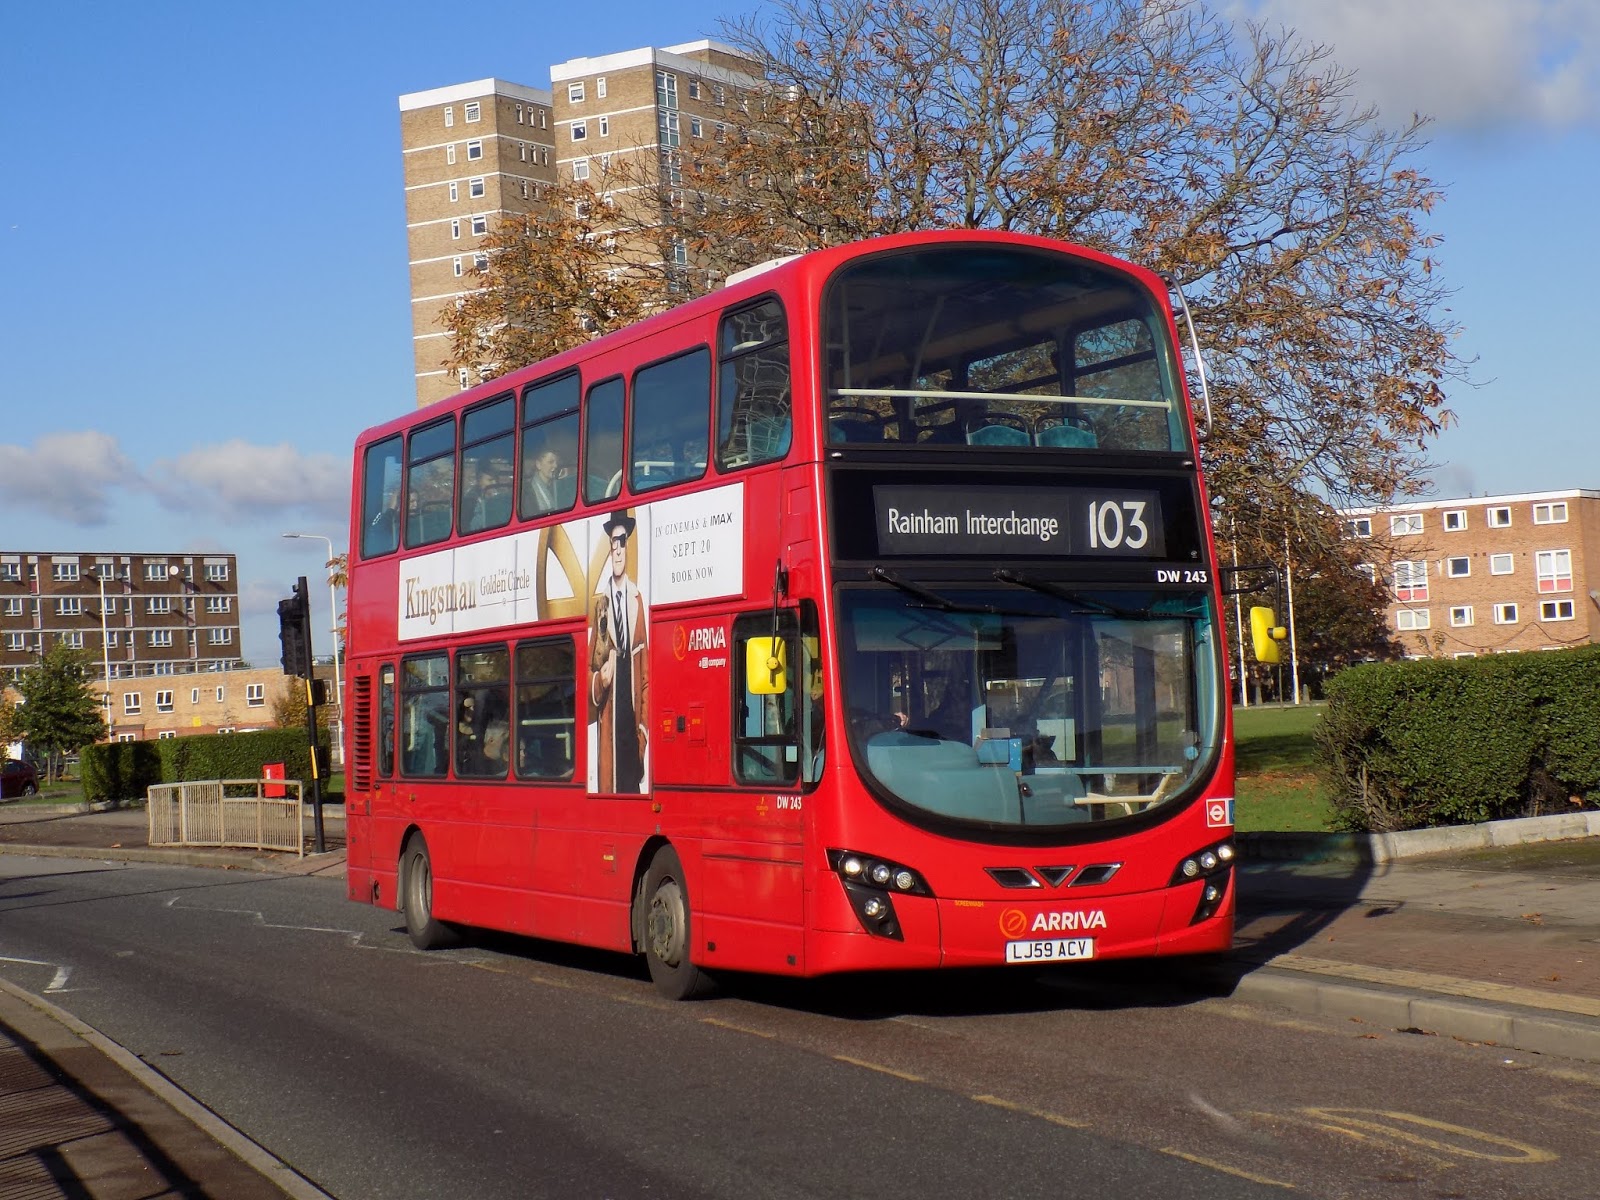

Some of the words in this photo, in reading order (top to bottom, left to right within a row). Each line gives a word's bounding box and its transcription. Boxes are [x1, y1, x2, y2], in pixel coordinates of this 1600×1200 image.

[655, 525, 663, 538] IN
[665, 518, 700, 535] CINEMAS
[709, 512, 733, 527] IMAX
[888, 508, 959, 534] Rainham
[966, 509, 1059, 541] Interchange
[1089, 500, 1149, 549] 103
[672, 541, 696, 559] SEPT
[700, 538, 711, 554] 20
[480, 574, 507, 596] Golden
[507, 568, 530, 592] Circle
[671, 569, 693, 584] BOOK
[695, 566, 714, 580] NOW
[1157, 570, 1181, 583] DW
[1184, 570, 1208, 584] 243
[405, 576, 477, 626] Kingsman
[687, 626, 727, 652] ARRIVA
[776, 795, 789, 810] DW
[790, 796, 802, 811] 243
[1031, 910, 1107, 932] ARRIVA
[1012, 942, 1053, 960] LJ59
[1057, 940, 1087, 957] ACV
